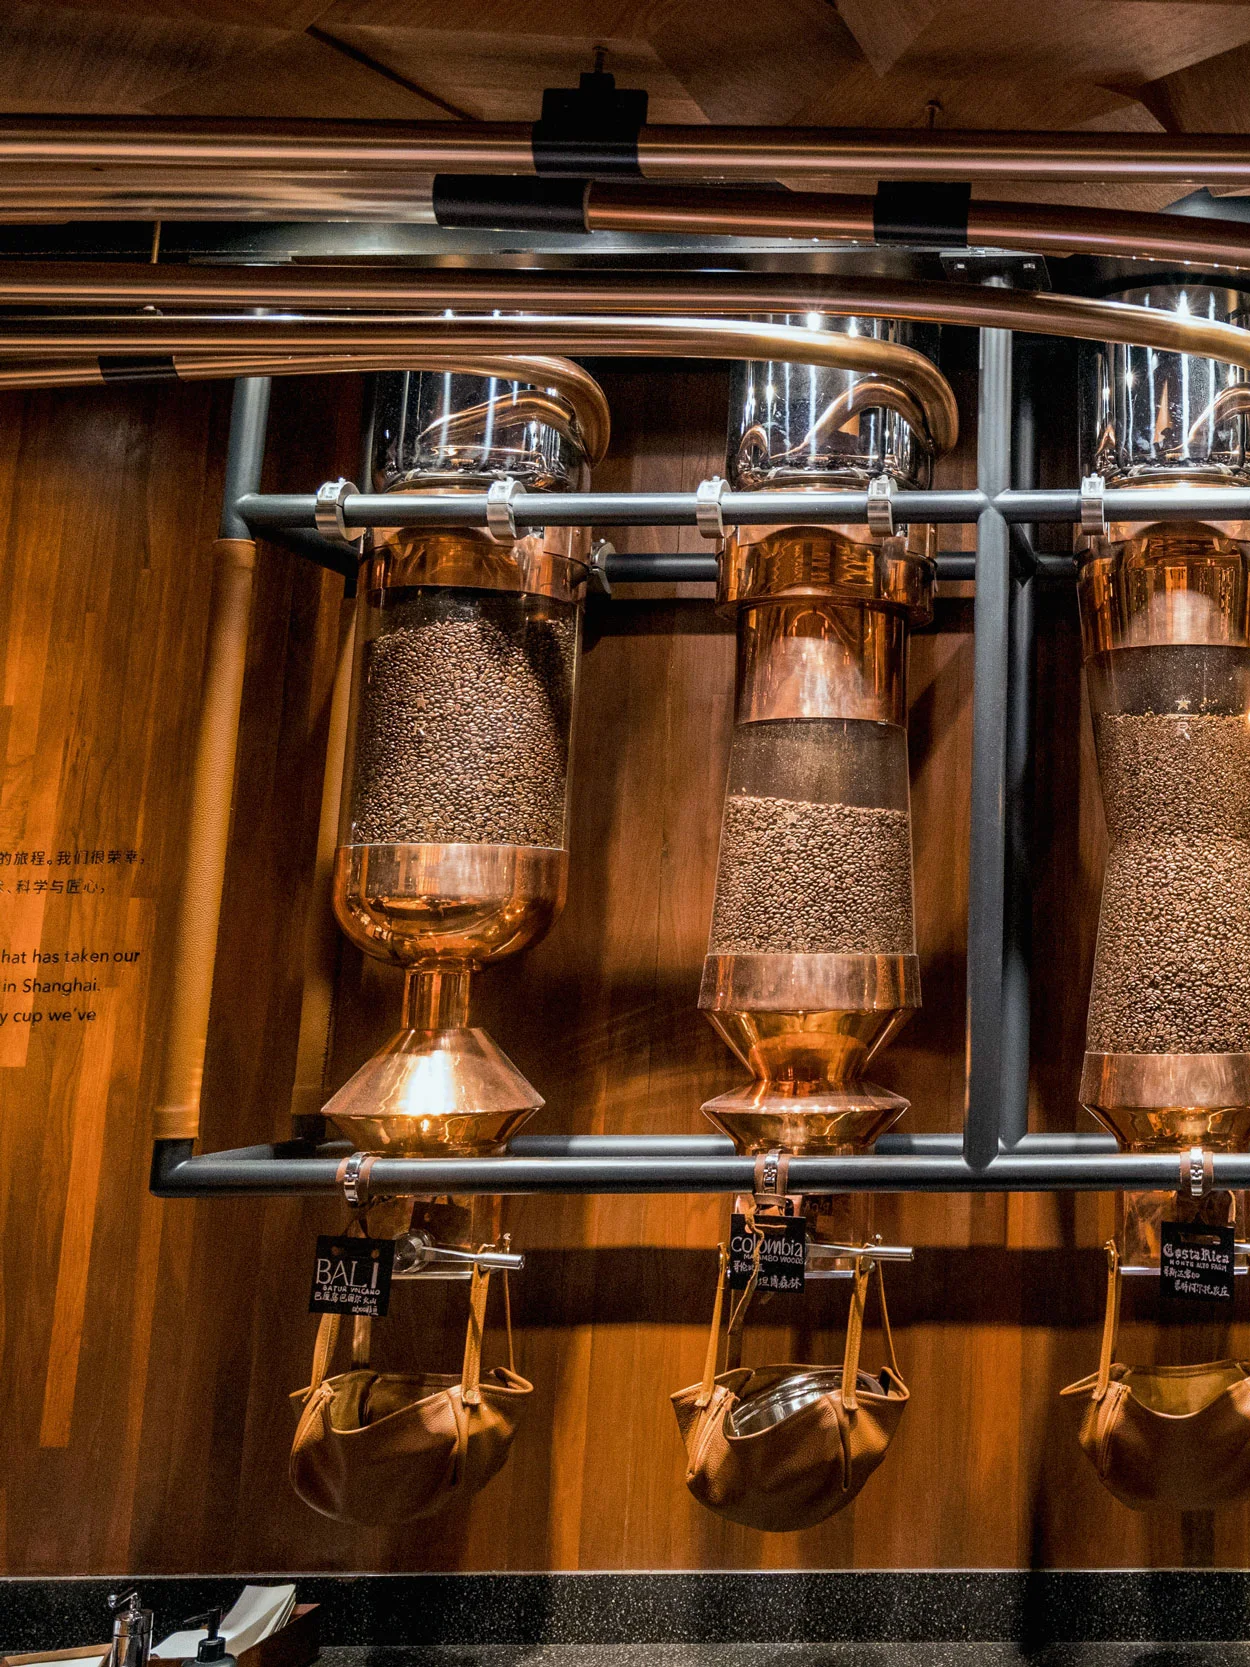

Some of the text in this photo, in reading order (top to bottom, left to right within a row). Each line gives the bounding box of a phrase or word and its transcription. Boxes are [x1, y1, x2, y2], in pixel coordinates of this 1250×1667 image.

[32, 949, 60, 964] has
[65, 948, 109, 964] taken
[113, 951, 141, 963] our
[3, 977, 101, 996] in Shanghai.
[13, 1011, 43, 1027] cup
[743, 1253, 779, 1263] MAAMBO
[315, 1258, 379, 1289] BALI
[322, 1284, 347, 1292] BATUR
